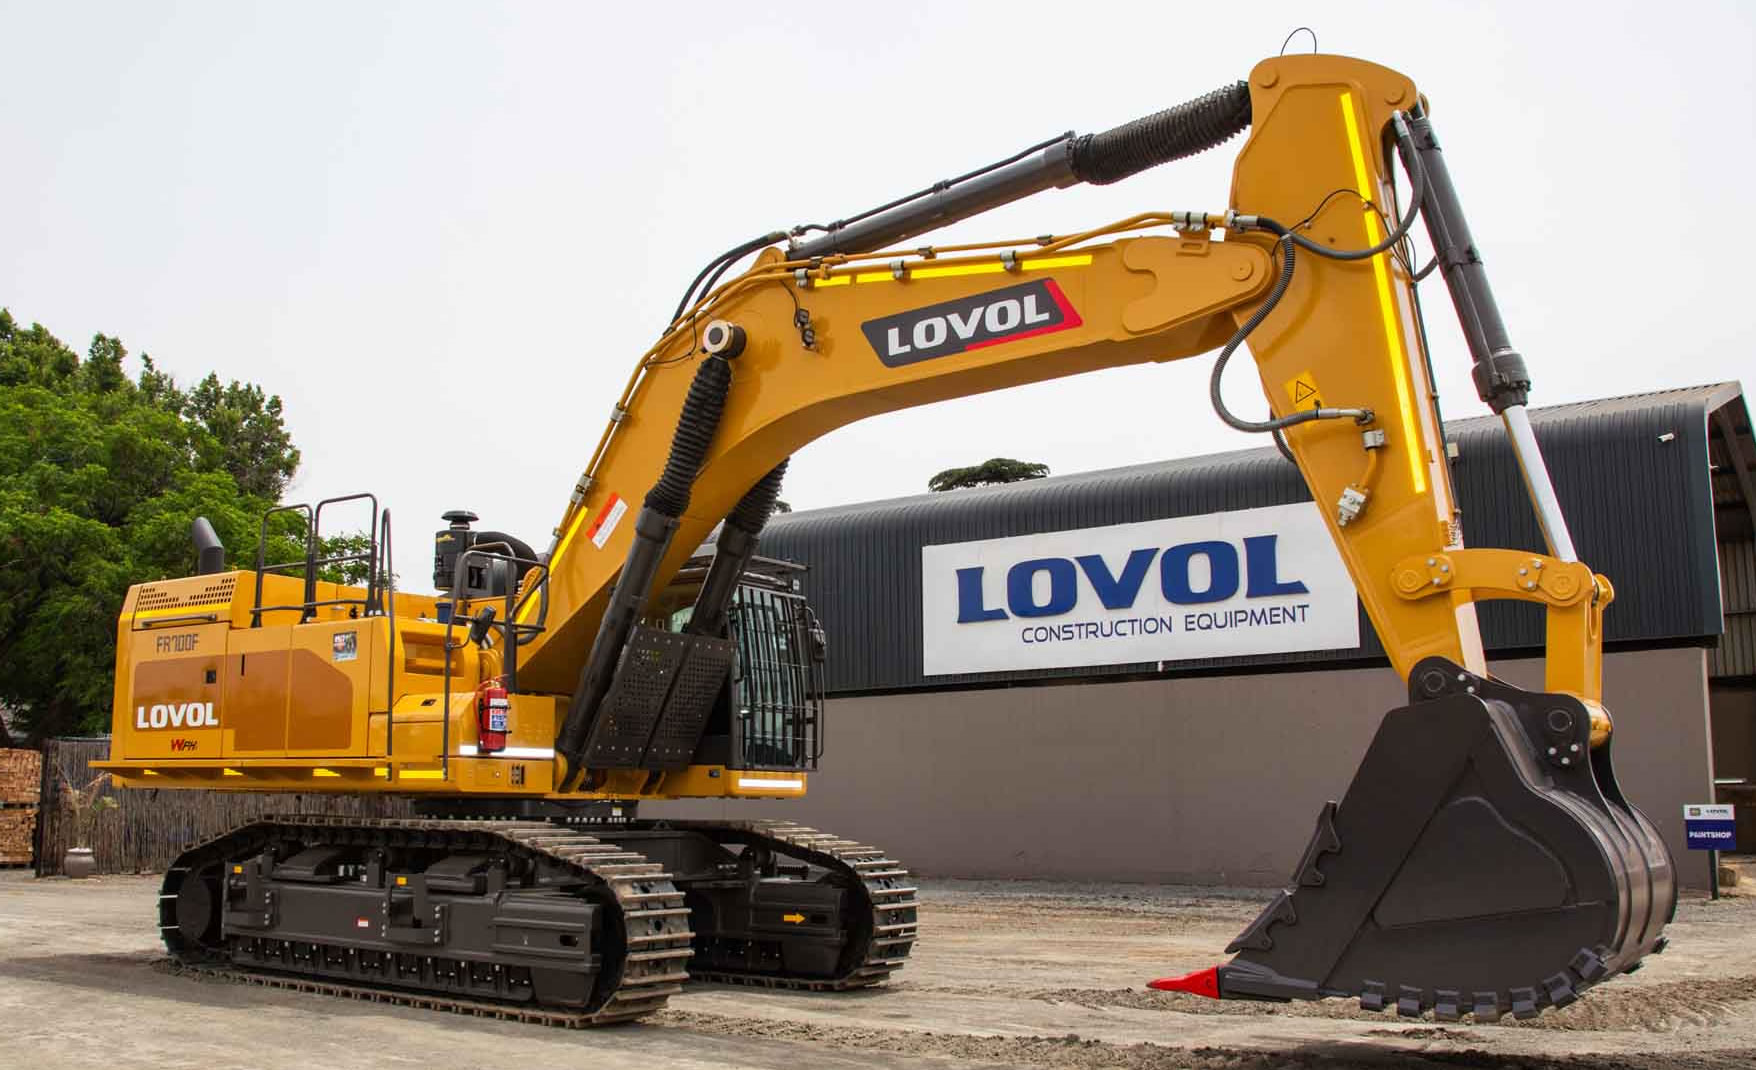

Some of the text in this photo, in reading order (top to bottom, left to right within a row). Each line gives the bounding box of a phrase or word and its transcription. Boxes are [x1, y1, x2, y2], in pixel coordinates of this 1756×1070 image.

[888, 294, 1049, 356] LOVOL
[956, 534, 1309, 623] LOVOL
[1021, 604, 1310, 643] CONSTRUCTION EQUIPMENT
[136, 702, 218, 729] LOVOL
